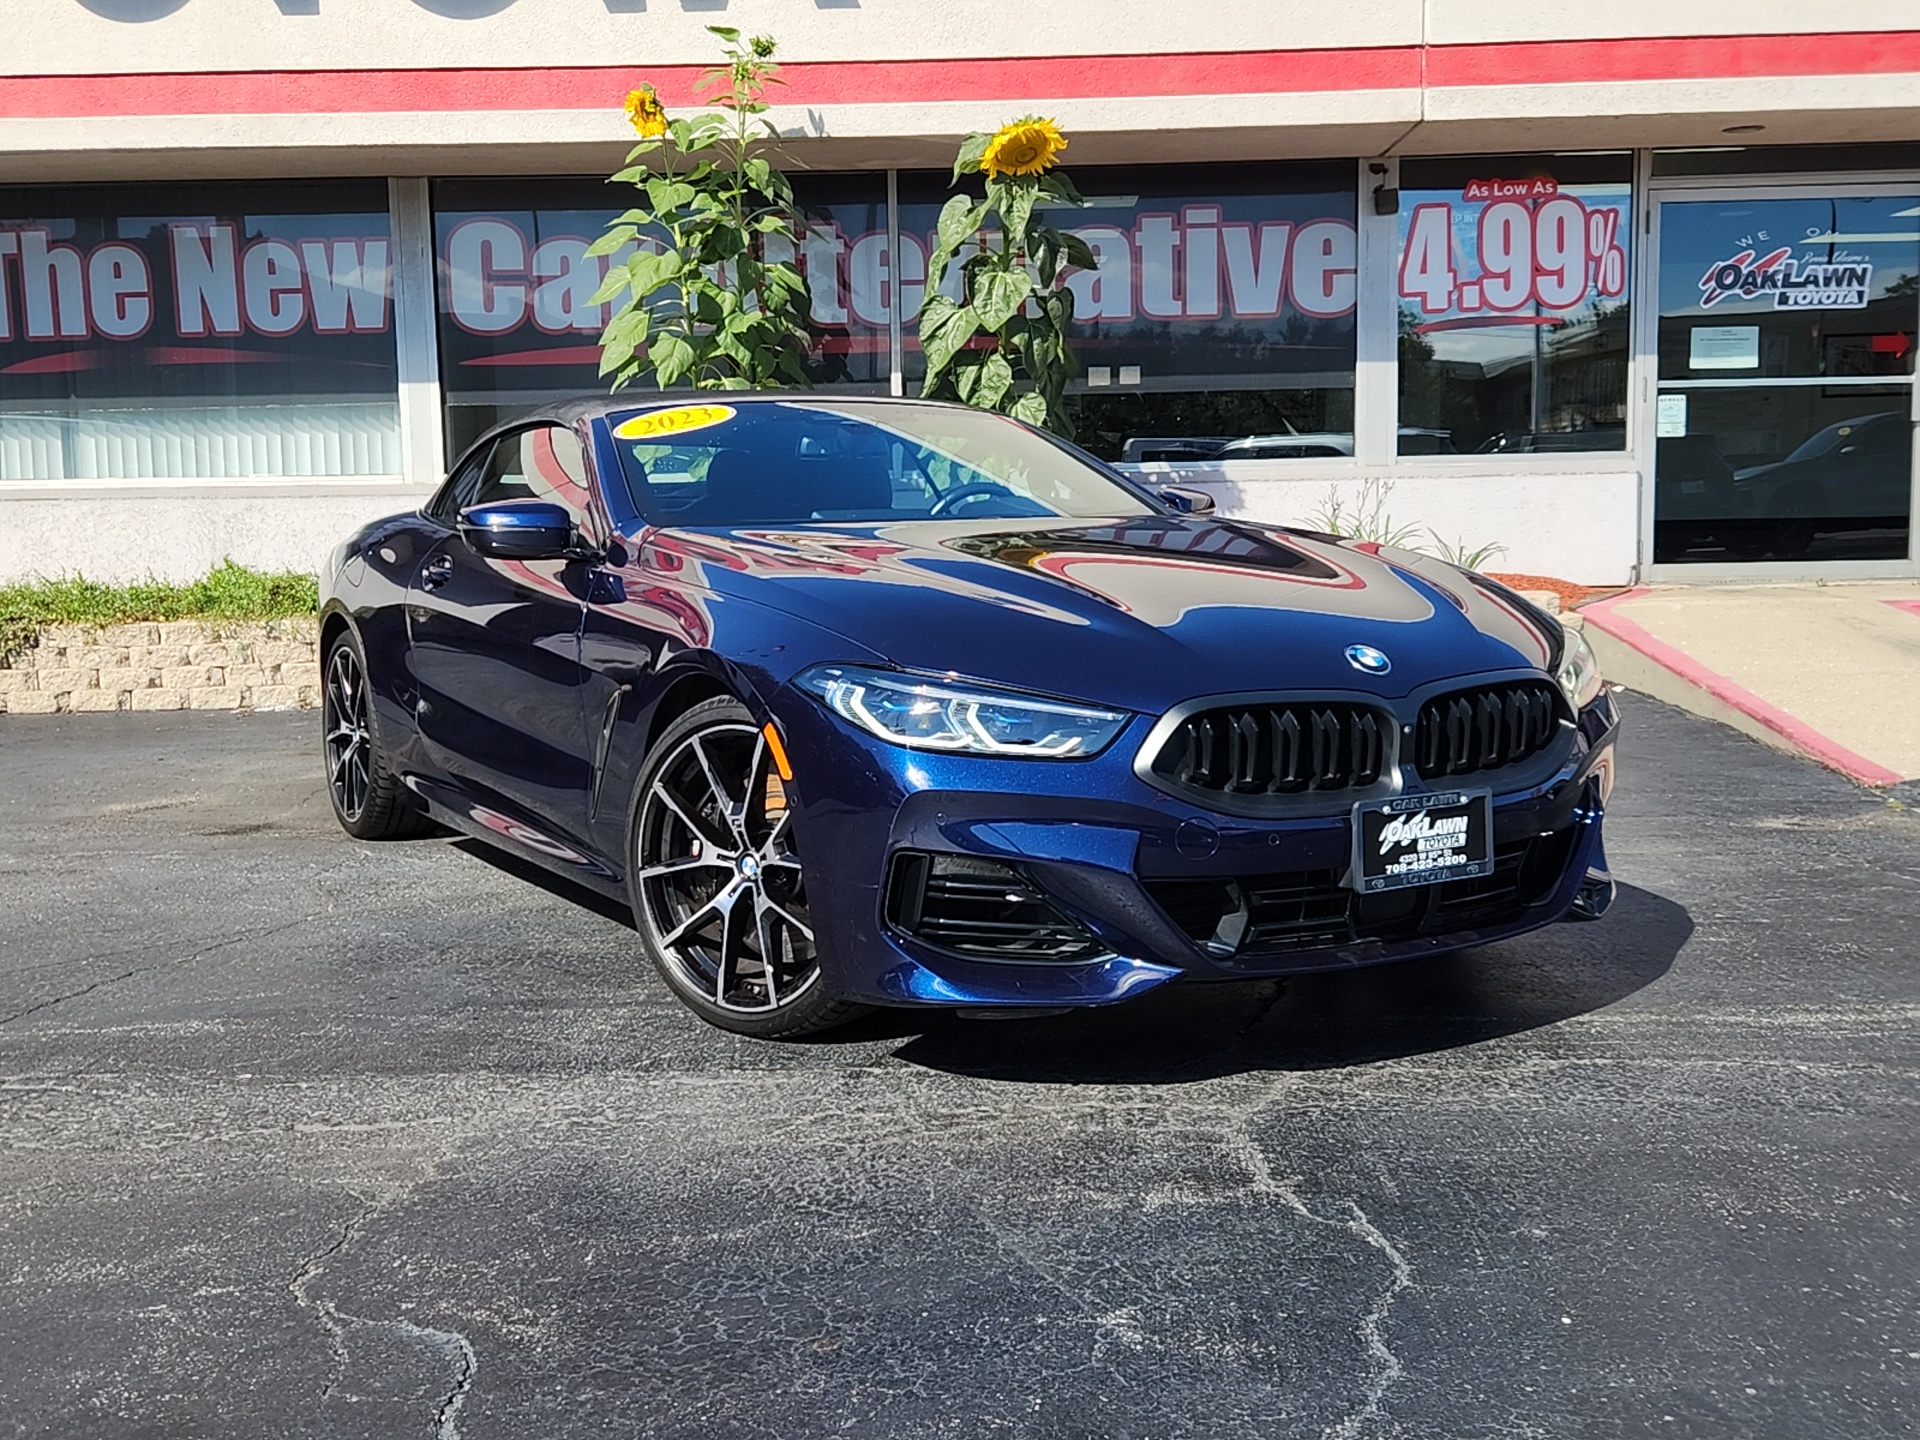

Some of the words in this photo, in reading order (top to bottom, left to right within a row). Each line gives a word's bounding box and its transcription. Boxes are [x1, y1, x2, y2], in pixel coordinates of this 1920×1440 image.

[1467, 183, 1490, 198] As
[1493, 182, 1528, 197] Low
[1532, 180, 1555, 195] As
[1401, 198, 1623, 311] 4.99%
[171, 223, 389, 337] New
[1785, 291, 1860, 305] TOYOTA
[641, 408, 713, 435] 2023
[1393, 798, 1420, 810] OAK
[1423, 794, 1458, 807] LAWN
[1423, 835, 1461, 850] TOYOTA
[1384, 854, 1467, 875] 708-423-5200
[1400, 869, 1452, 884] TOYOTA
